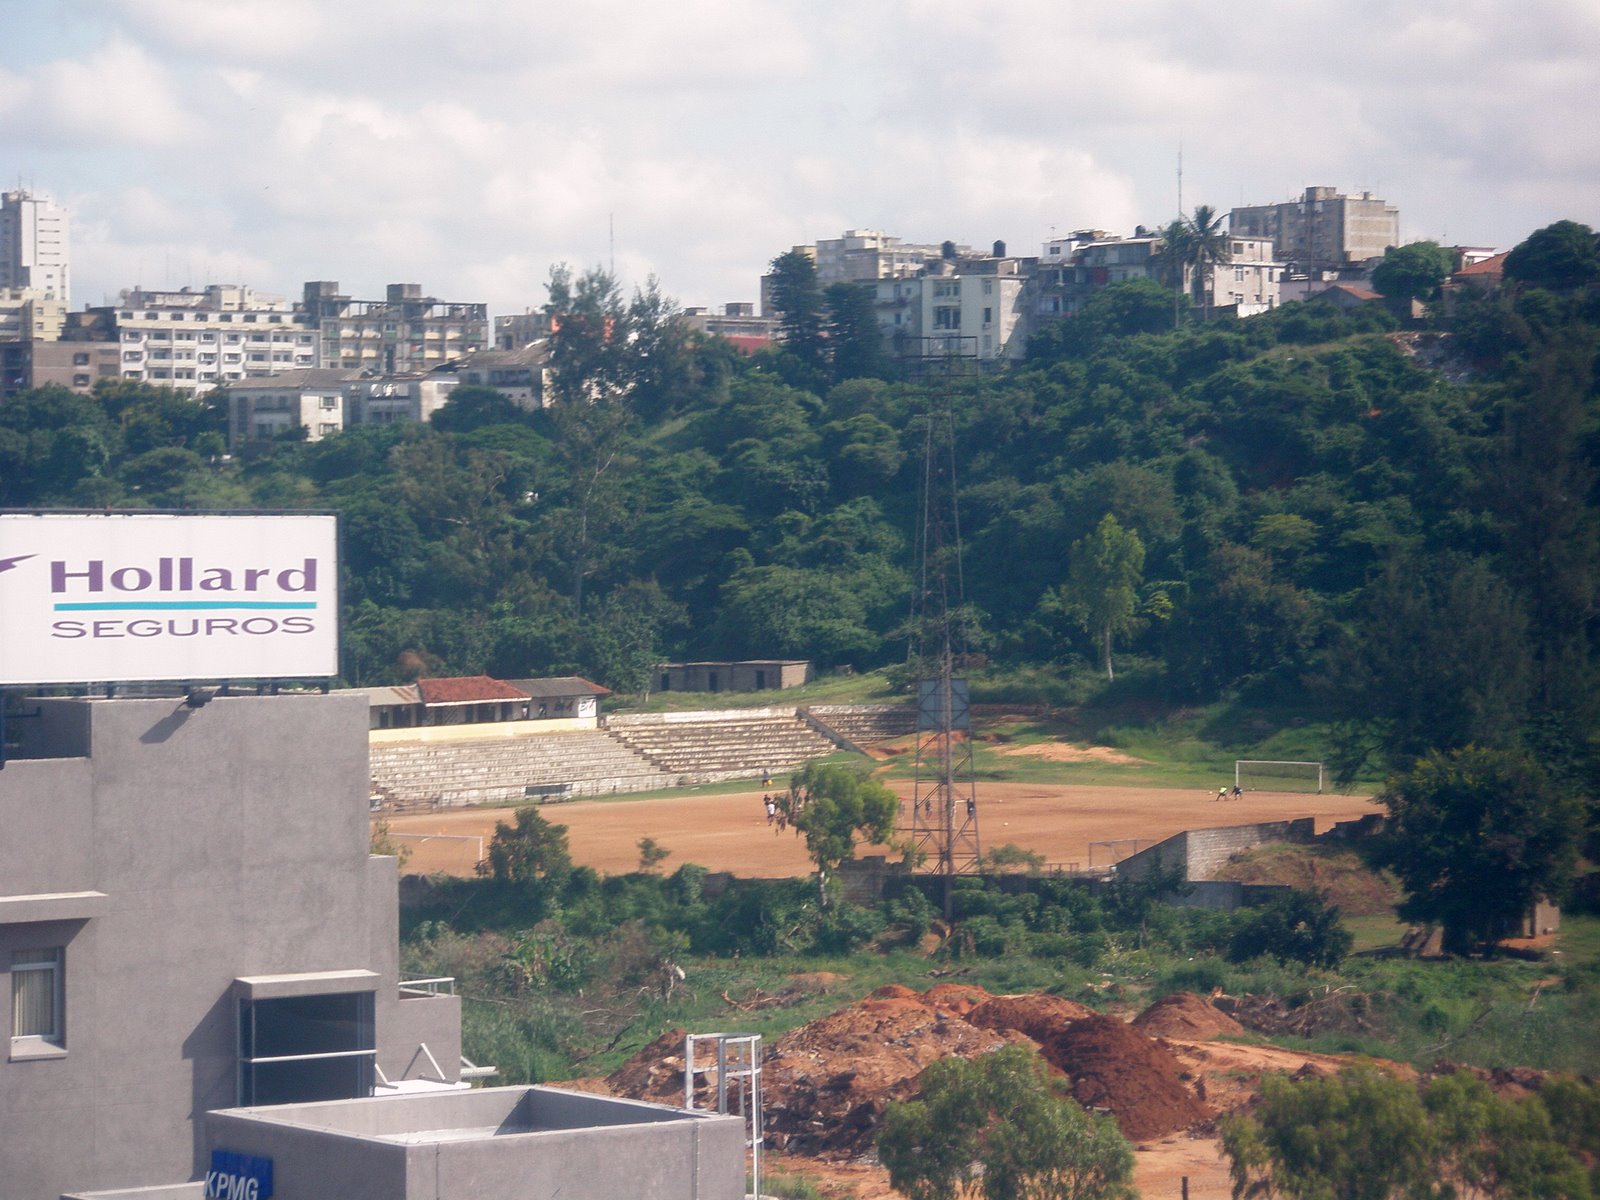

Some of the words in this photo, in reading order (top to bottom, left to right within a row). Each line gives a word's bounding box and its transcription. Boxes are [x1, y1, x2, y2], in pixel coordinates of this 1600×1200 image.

[50, 557, 318, 593] Hollard
[50, 616, 316, 639] SEGUROS
[203, 1170, 259, 1200] KPMG
